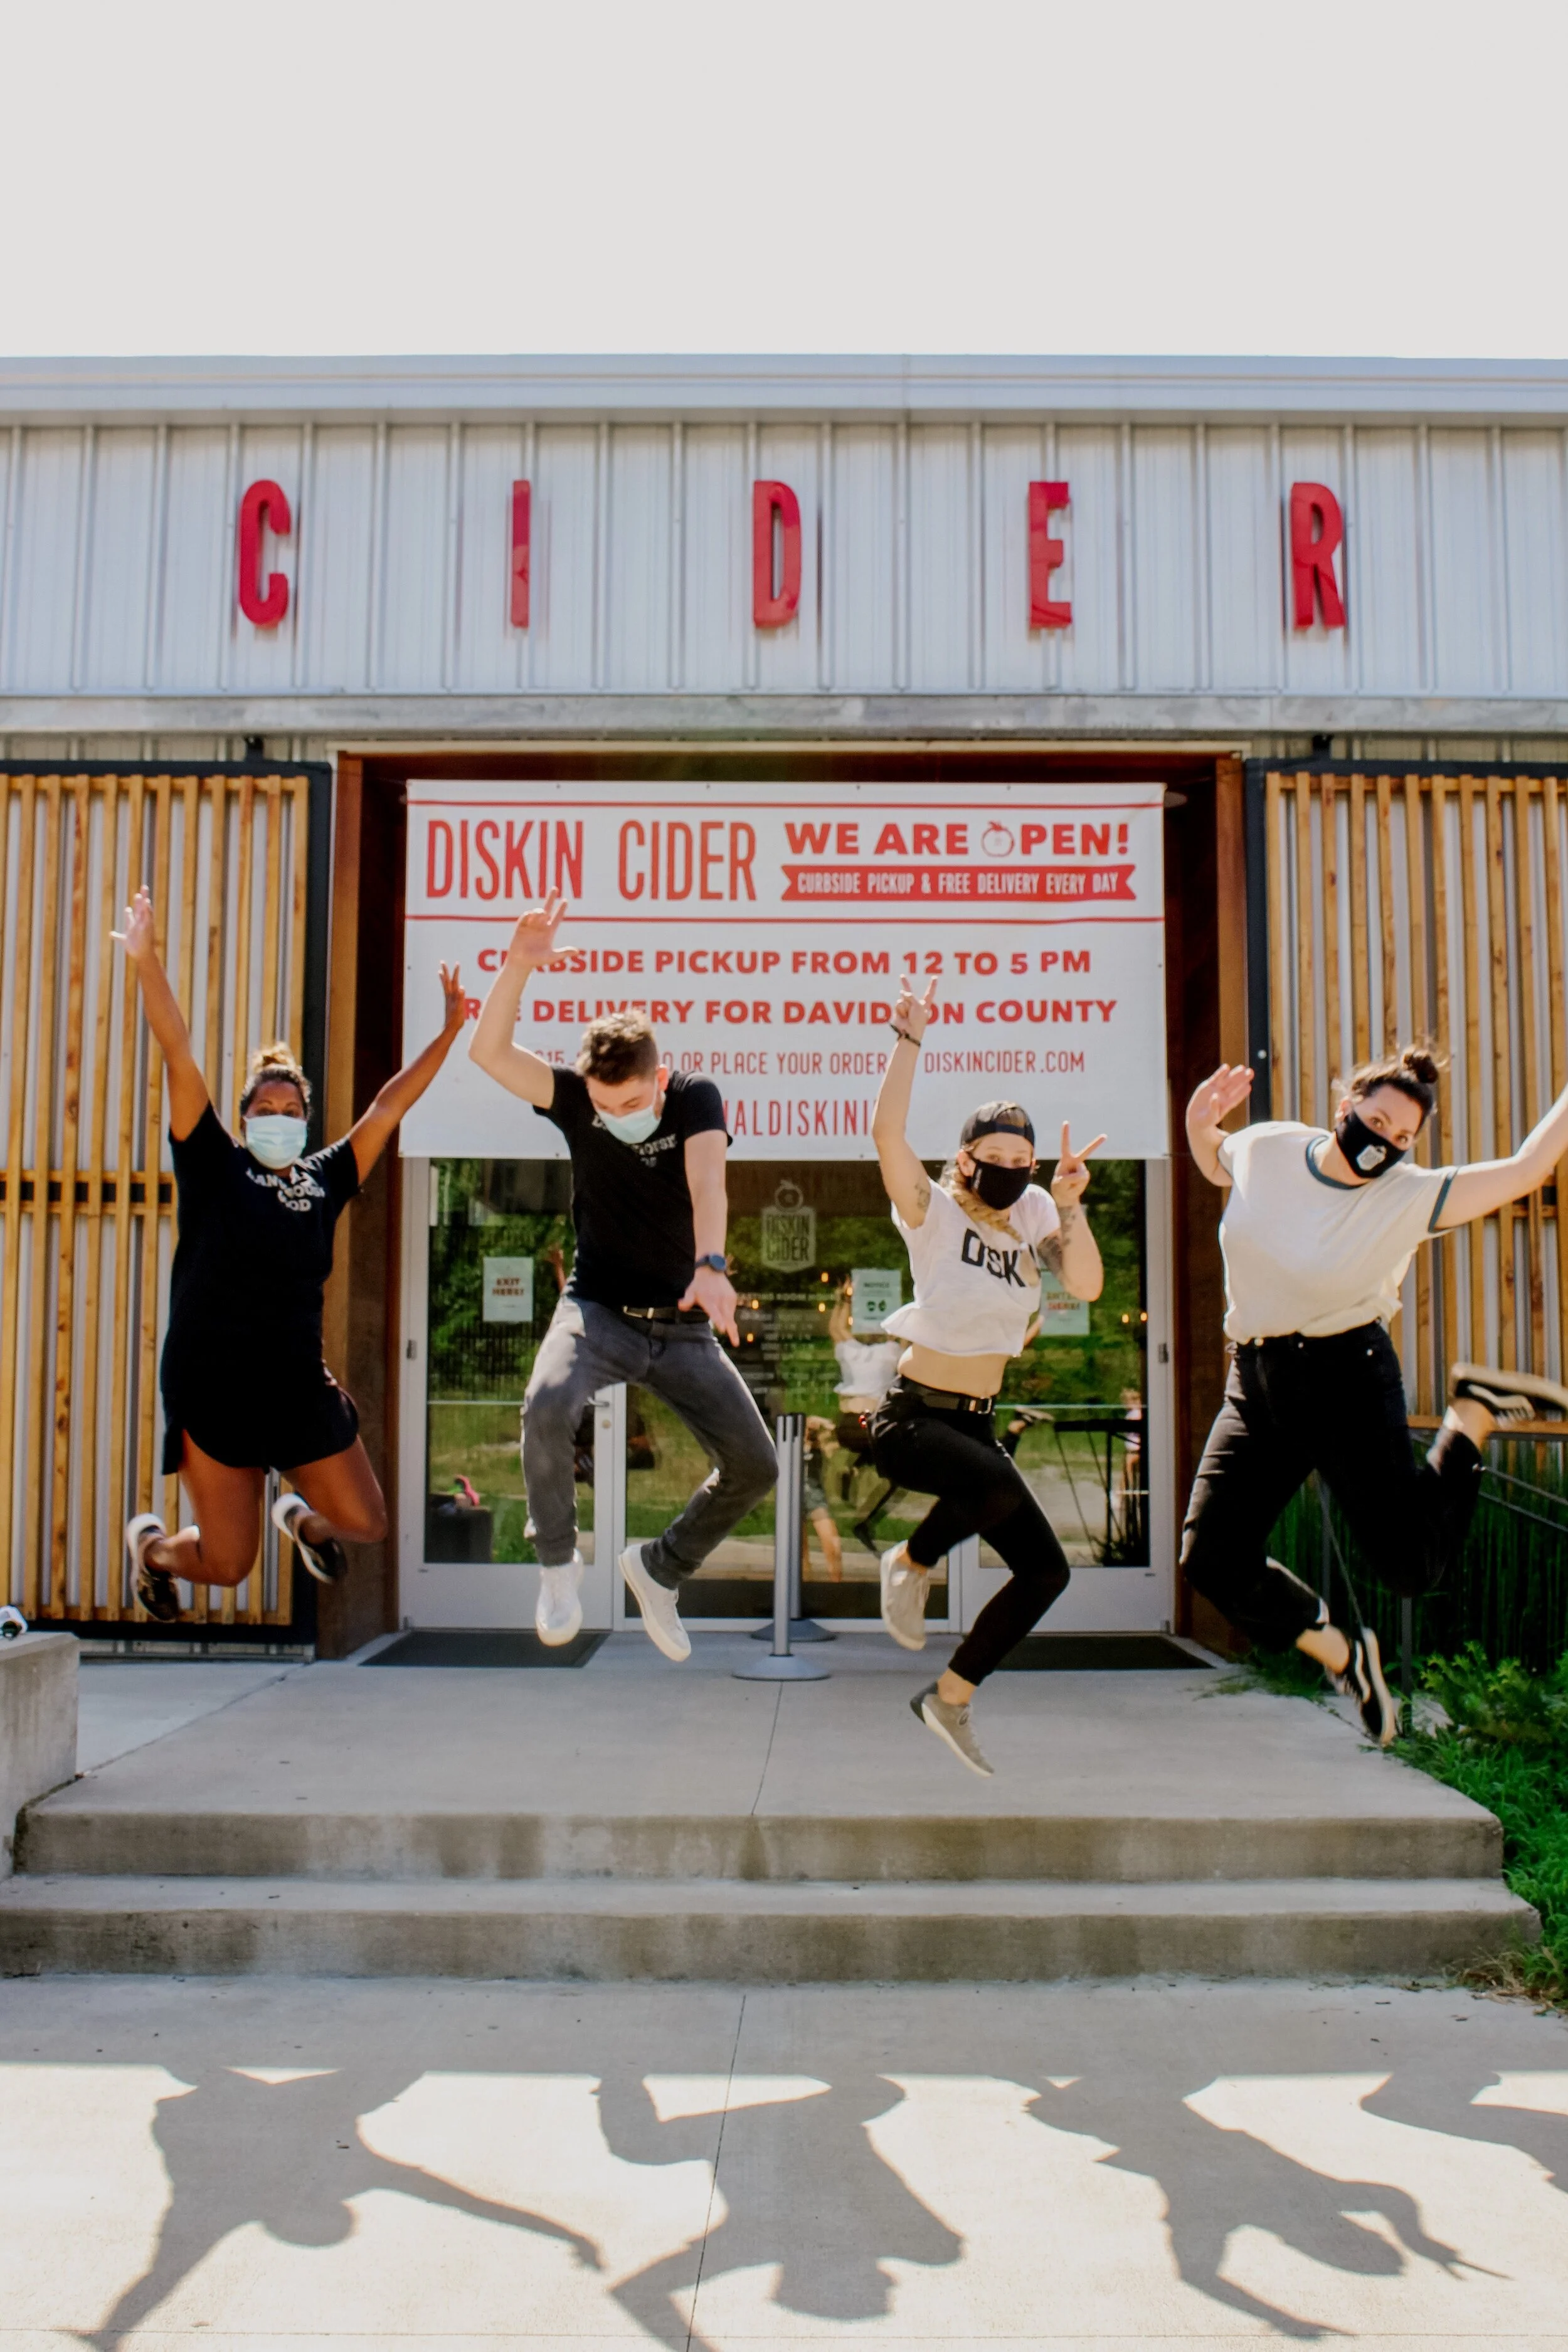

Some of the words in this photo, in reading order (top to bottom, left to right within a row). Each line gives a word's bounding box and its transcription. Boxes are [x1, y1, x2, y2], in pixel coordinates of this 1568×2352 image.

[239, 479, 1347, 630] CIDER
[785, 822, 859, 856] WE
[874, 822, 968, 856] ARE
[426, 820, 583, 899] DISKIN
[618, 820, 756, 901] CIDER
[797, 872, 860, 894] CURBSIDE
[867, 872, 915, 895] PICKUP
[921, 872, 932, 894] &
[938, 872, 970, 895] FREE
[977, 872, 1040, 895] DELIVERY
[1046, 872, 1086, 896] EVERY
[1092, 872, 1118, 894] DAY
[655, 950, 781, 974] PICKUP
[792, 951, 889, 974] FROM
[903, 951, 943, 975] 12
[954, 951, 998, 975] TO
[1010, 952, 1028, 975] 5
[1041, 950, 1091, 973] PM
[706, 1000, 771, 1024] FOR
[784, 1002, 963, 1025] DAVIDON
[976, 1000, 1116, 1024] COUNTY
[681, 1051, 703, 1073] OR
[711, 1052, 768, 1074] PLACE
[777, 1052, 822, 1074] YOUR
[830, 1053, 887, 1075] ORDER
